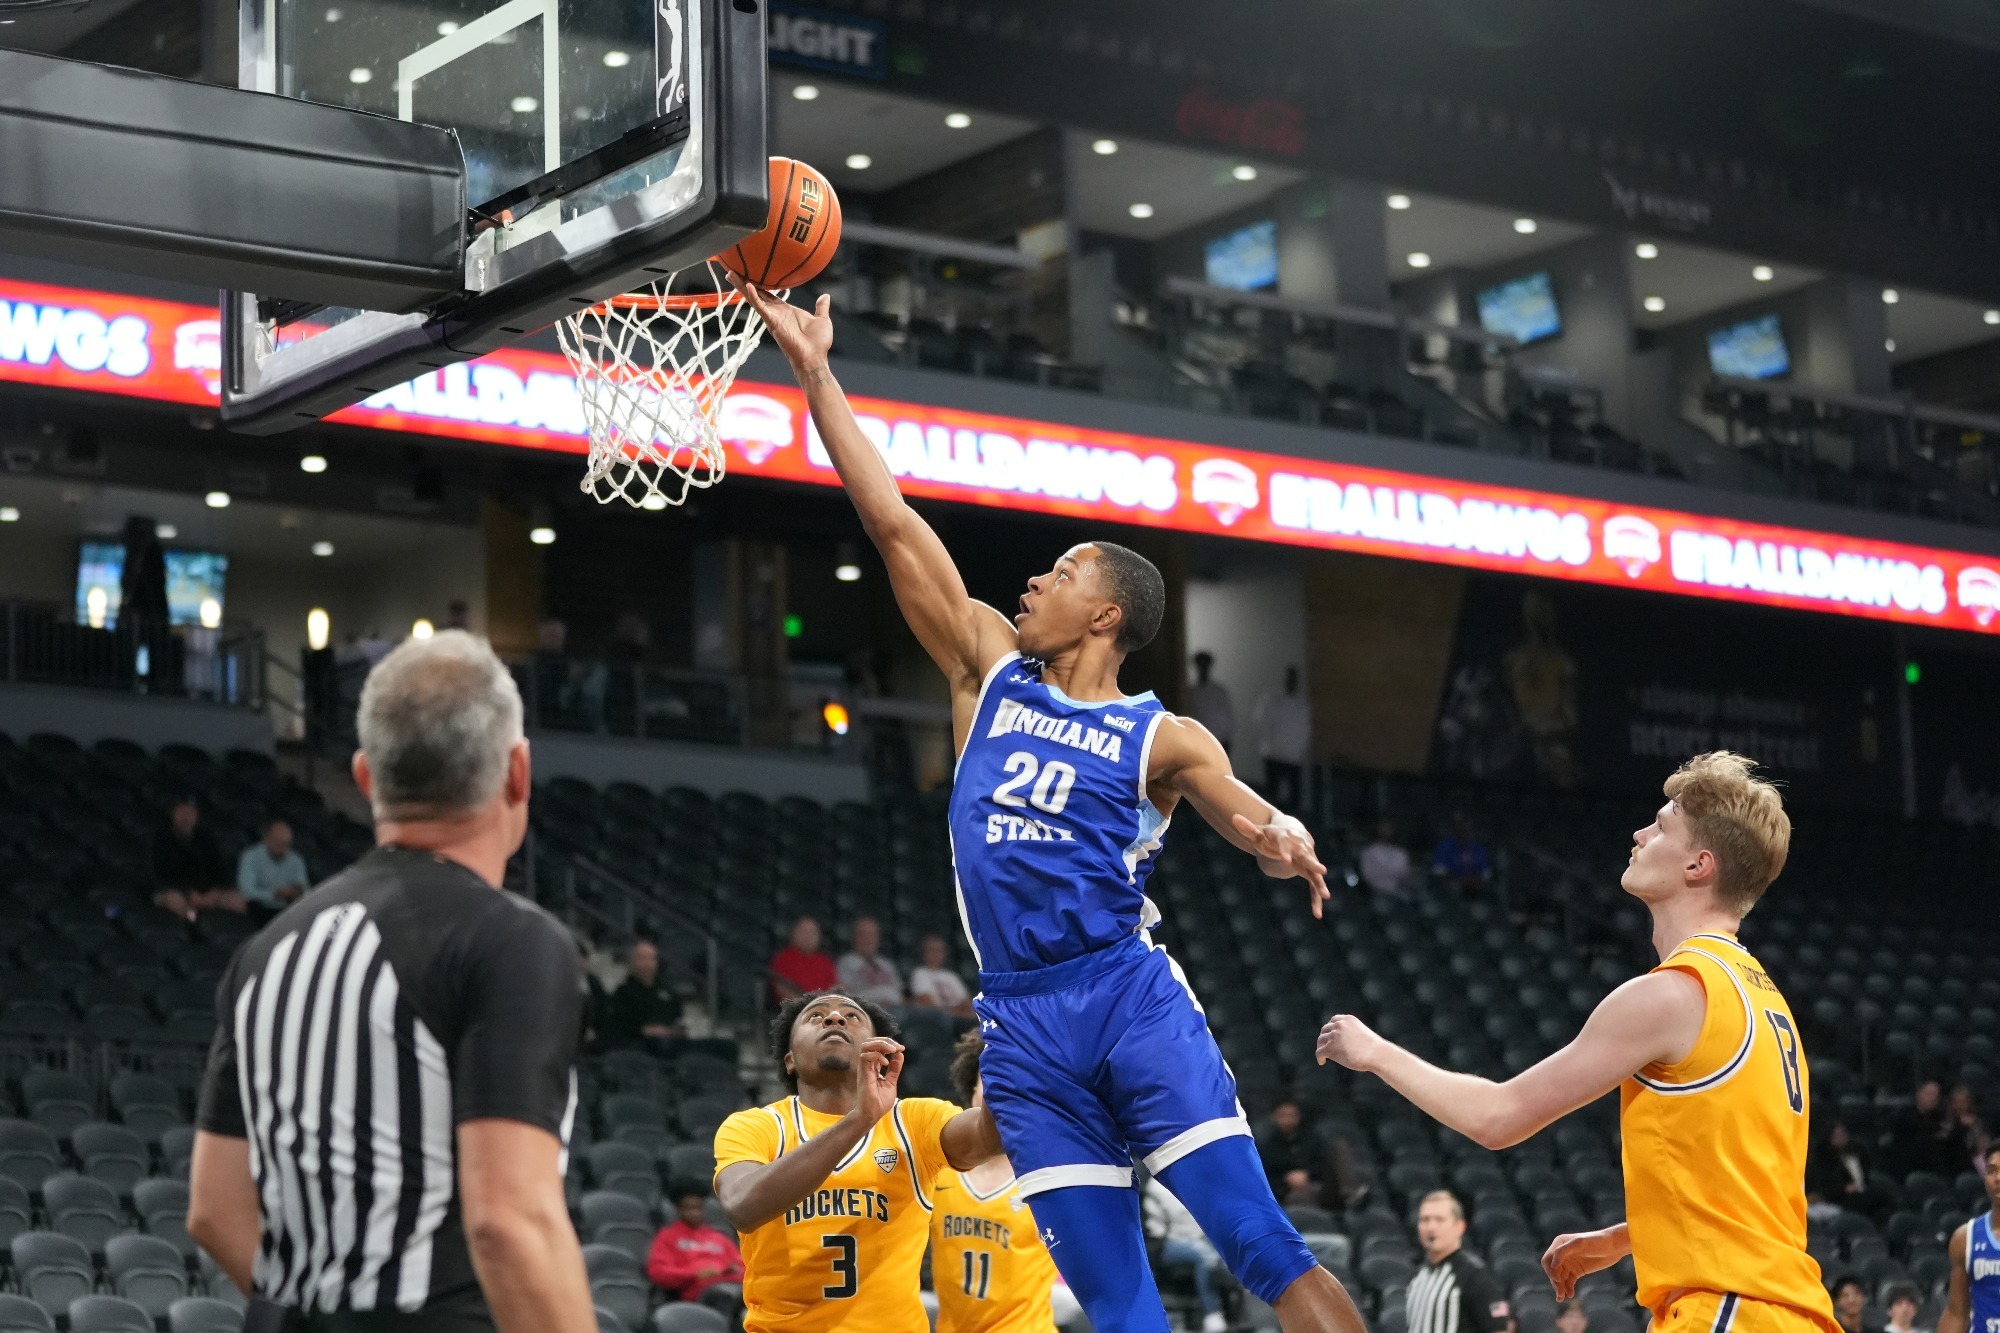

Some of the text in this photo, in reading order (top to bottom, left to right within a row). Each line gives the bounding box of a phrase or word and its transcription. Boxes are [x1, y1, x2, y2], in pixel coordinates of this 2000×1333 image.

[788, 176, 818, 244] ELITE
[987, 697, 1122, 763] INDIANA
[992, 751, 1077, 814] 20
[1764, 1009, 1803, 1114] 13
[943, 1214, 1010, 1250] ROCKETS
[822, 1234, 858, 1299] 3
[963, 1250, 990, 1299] 11
